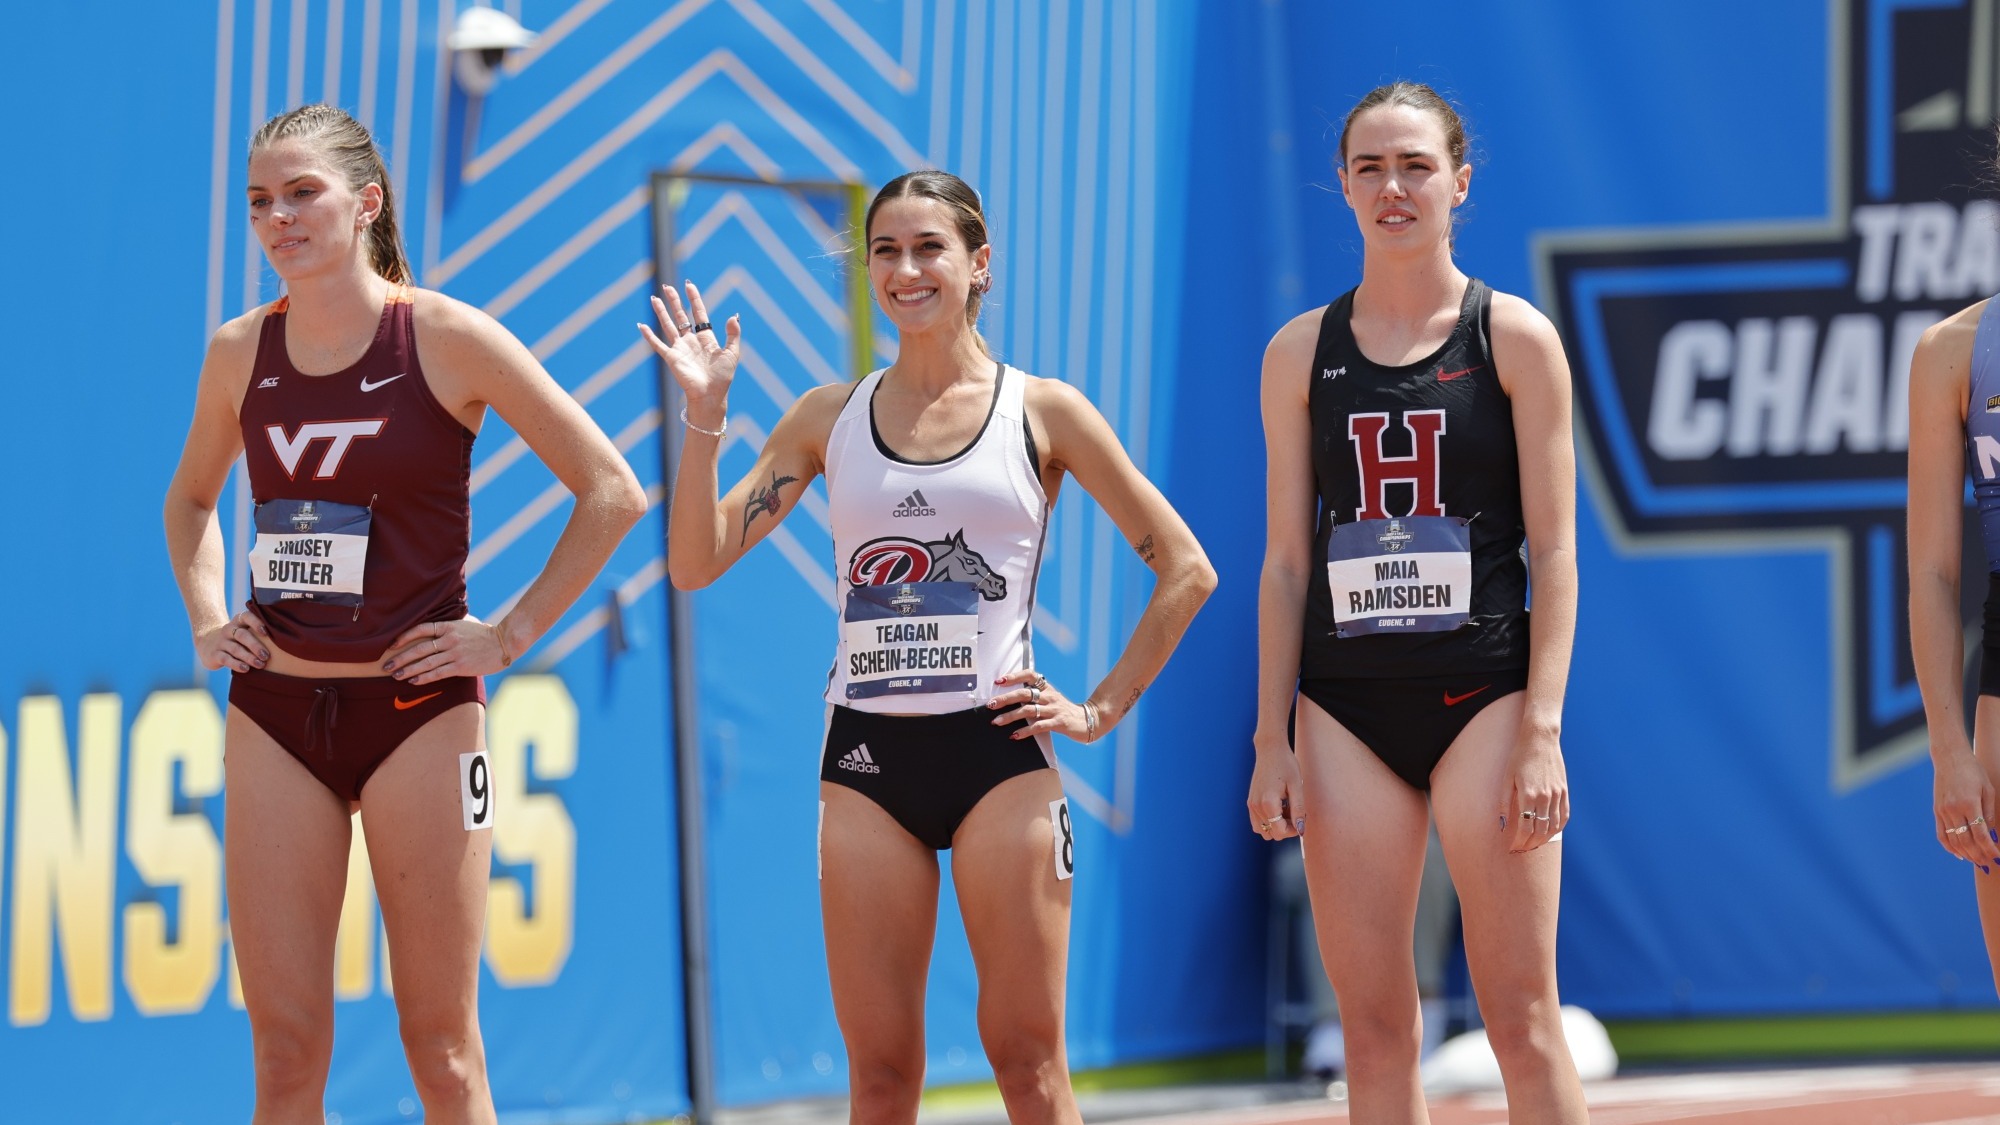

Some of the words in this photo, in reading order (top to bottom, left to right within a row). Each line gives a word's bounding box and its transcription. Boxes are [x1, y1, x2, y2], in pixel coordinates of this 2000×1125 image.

[258, 377, 280, 388] ACC
[1323, 368, 1338, 380] Ivy
[264, 418, 388, 482] VT
[1348, 409, 1446, 522] H
[892, 506, 936, 518] adidas
[268, 559, 333, 586] BUTLER
[1375, 560, 1420, 581] MAIA
[1348, 584, 1451, 614] RAMSDEN
[876, 622, 939, 643] TEAGAN
[1406, 618, 1416, 626] OR
[850, 645, 973, 676] SCHEIN-BECKER
[912, 678, 922, 687] OR
[838, 759, 880, 774] adidas
[469, 755, 489, 824] 9
[1059, 803, 1073, 875] 8
